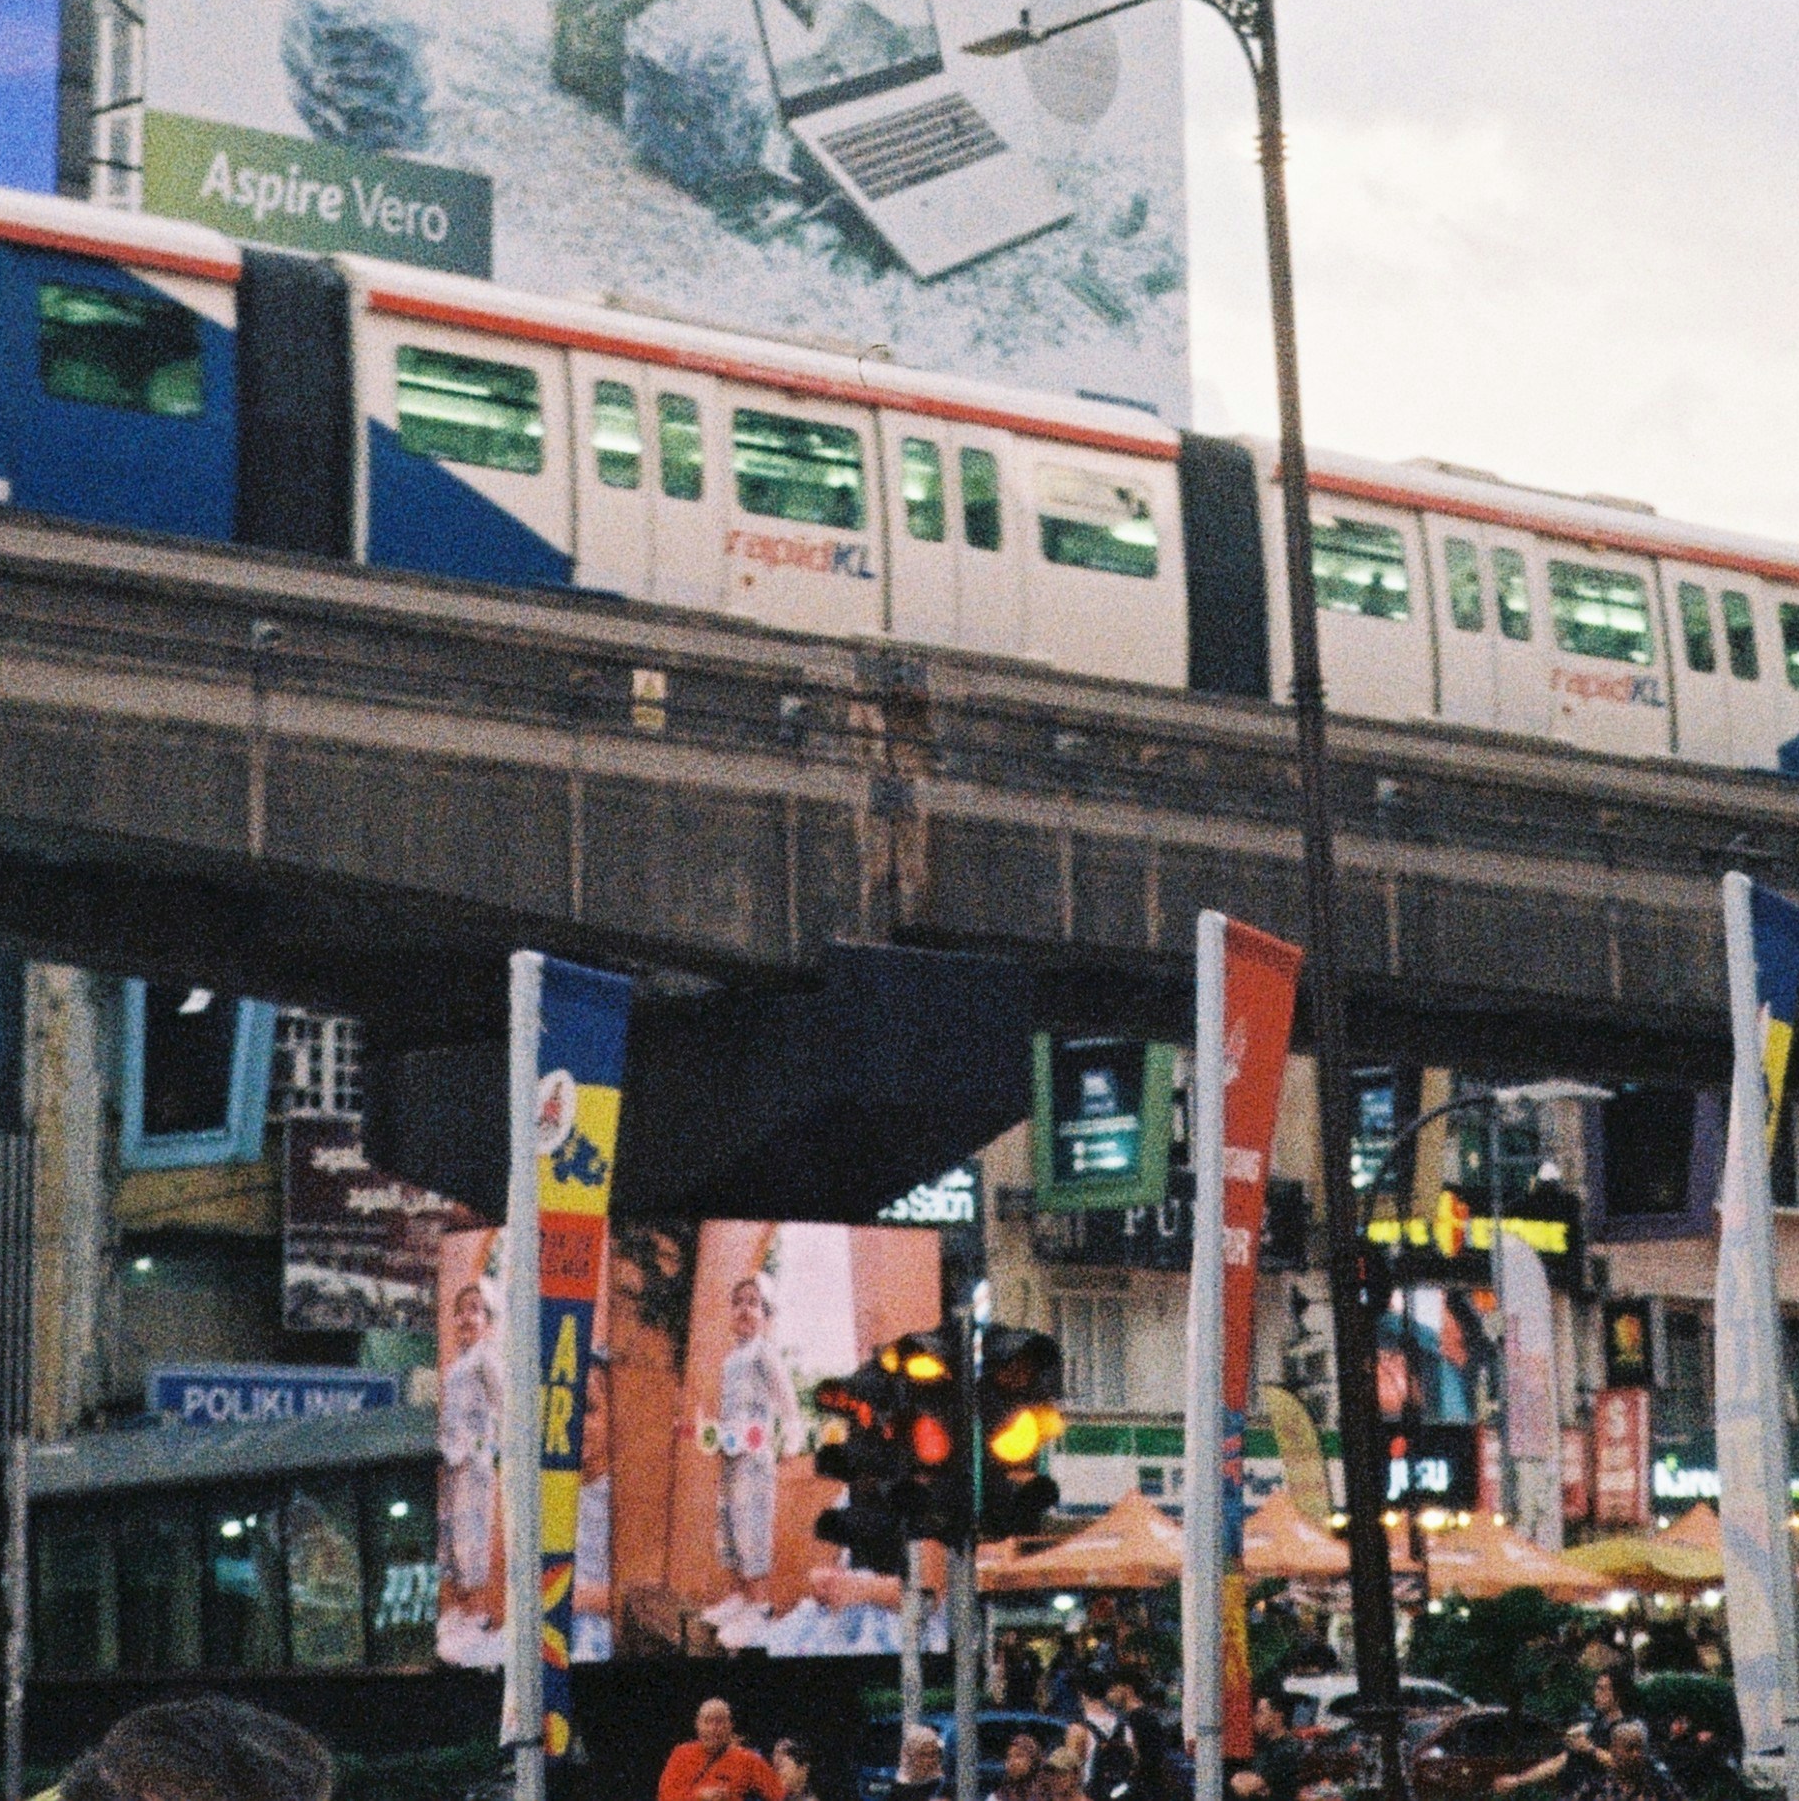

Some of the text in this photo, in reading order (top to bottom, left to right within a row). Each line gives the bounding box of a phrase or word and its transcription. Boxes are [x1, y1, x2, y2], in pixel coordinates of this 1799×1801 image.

[201, 151, 449, 243] Aspire Vero
[725, 530, 875, 579] rapidKL
